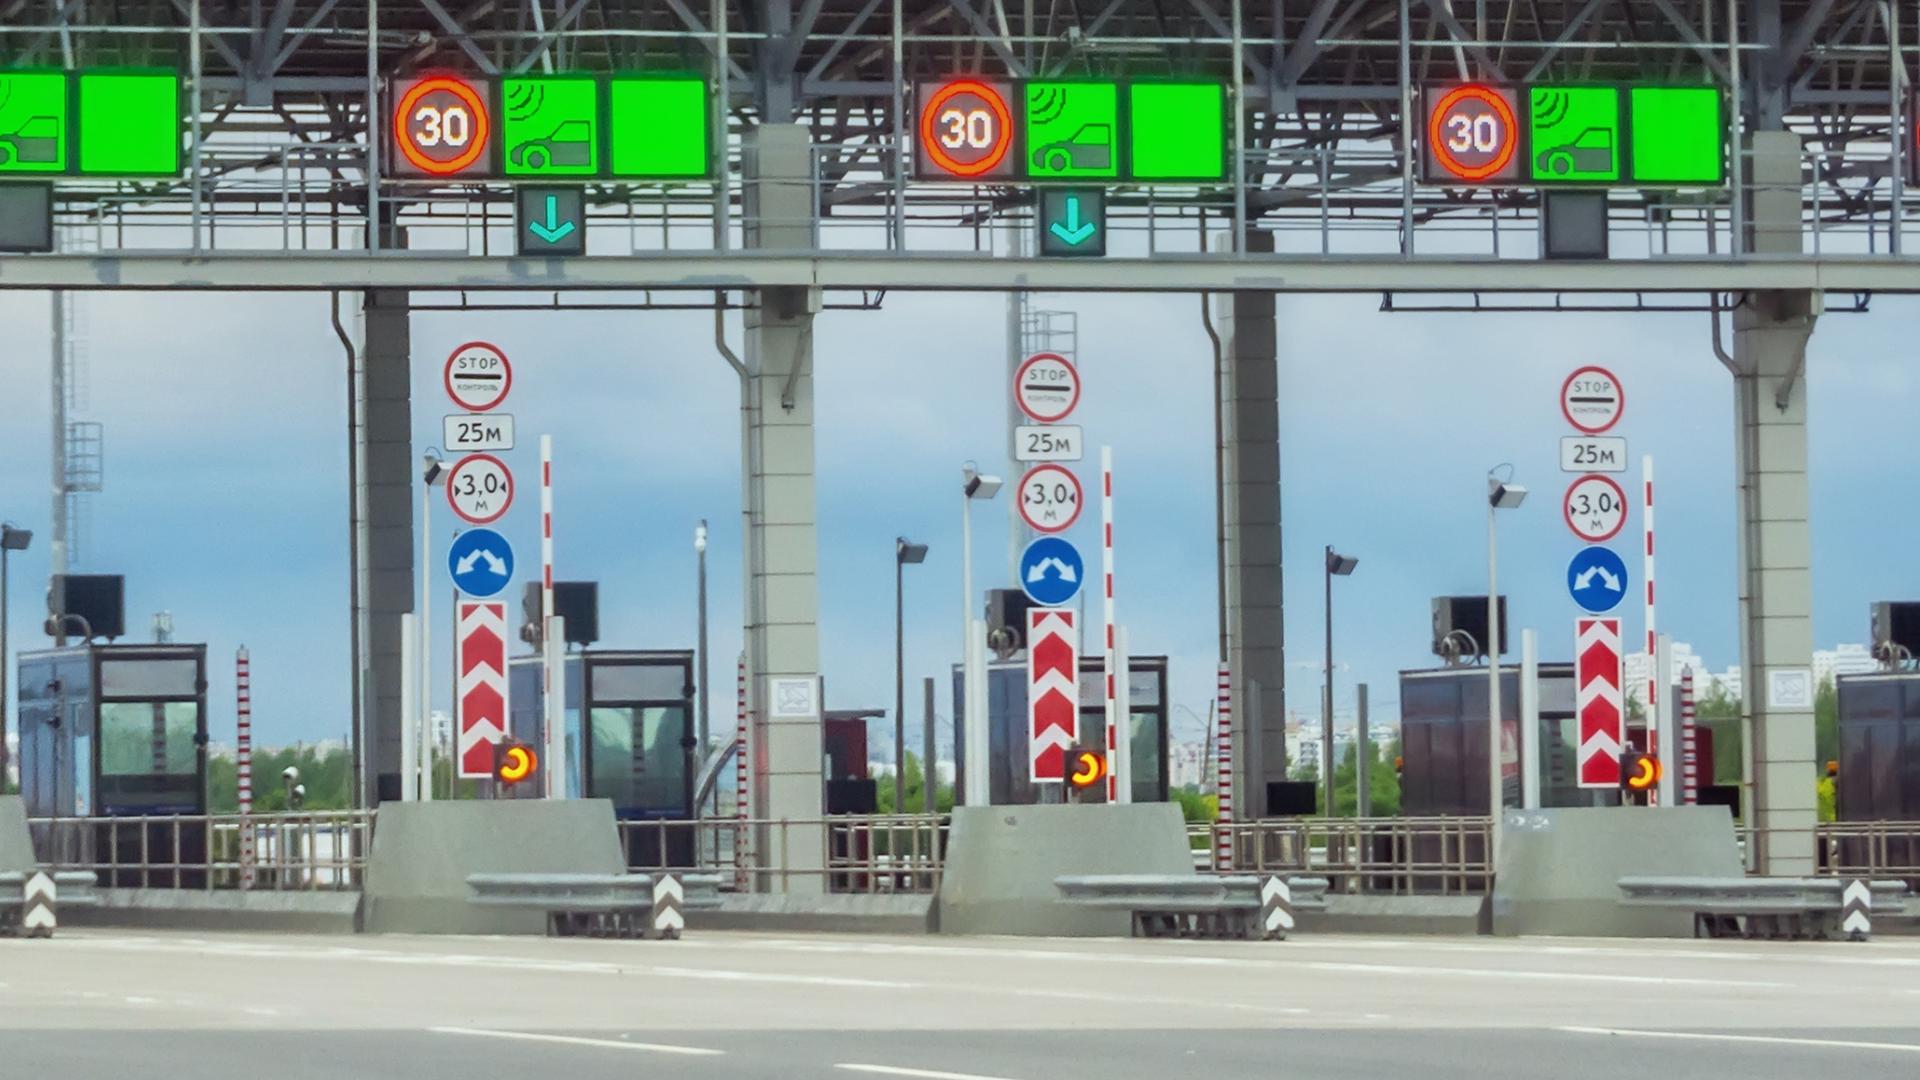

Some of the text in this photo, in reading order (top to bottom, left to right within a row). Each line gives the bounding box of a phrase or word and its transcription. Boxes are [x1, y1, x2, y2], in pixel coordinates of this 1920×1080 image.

[415, 106, 468, 147] 30
[941, 109, 992, 149] 30
[1448, 114, 1497, 153] 30
[458, 357, 499, 370] STOP
[1029, 368, 1068, 381] STOP
[1574, 381, 1611, 393] STOP
